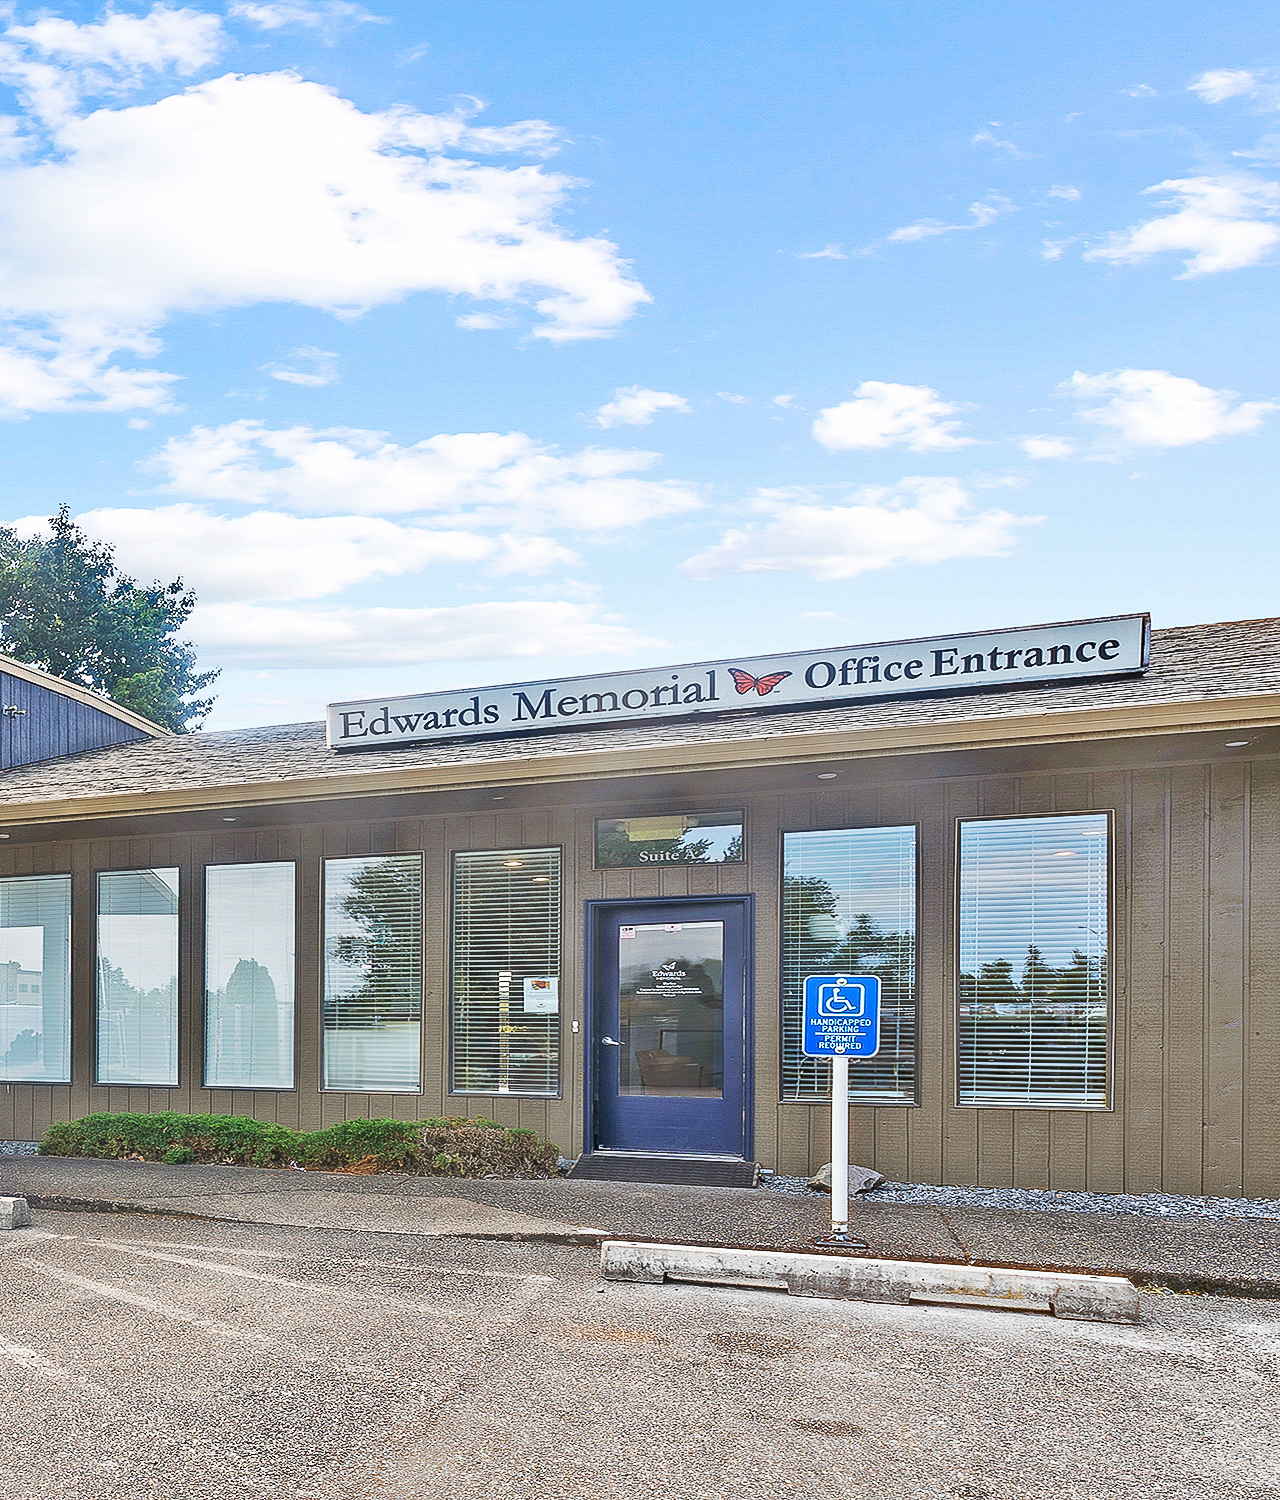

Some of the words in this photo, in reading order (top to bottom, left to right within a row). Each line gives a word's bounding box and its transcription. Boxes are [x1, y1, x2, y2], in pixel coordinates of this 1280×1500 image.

[338, 696, 501, 739] Edwards
[511, 670, 721, 722] Memorial
[804, 655, 924, 689] Office
[929, 638, 1121, 678] Entrance
[638, 850, 680, 863] Suite
[684, 849, 697, 860] A
[810, 1018, 872, 1027] HANDICAPPED
[821, 1025, 860, 1033] PARKING
[824, 1035, 857, 1043] PERMIT
[818, 1041, 862, 1050] REQUIRED
